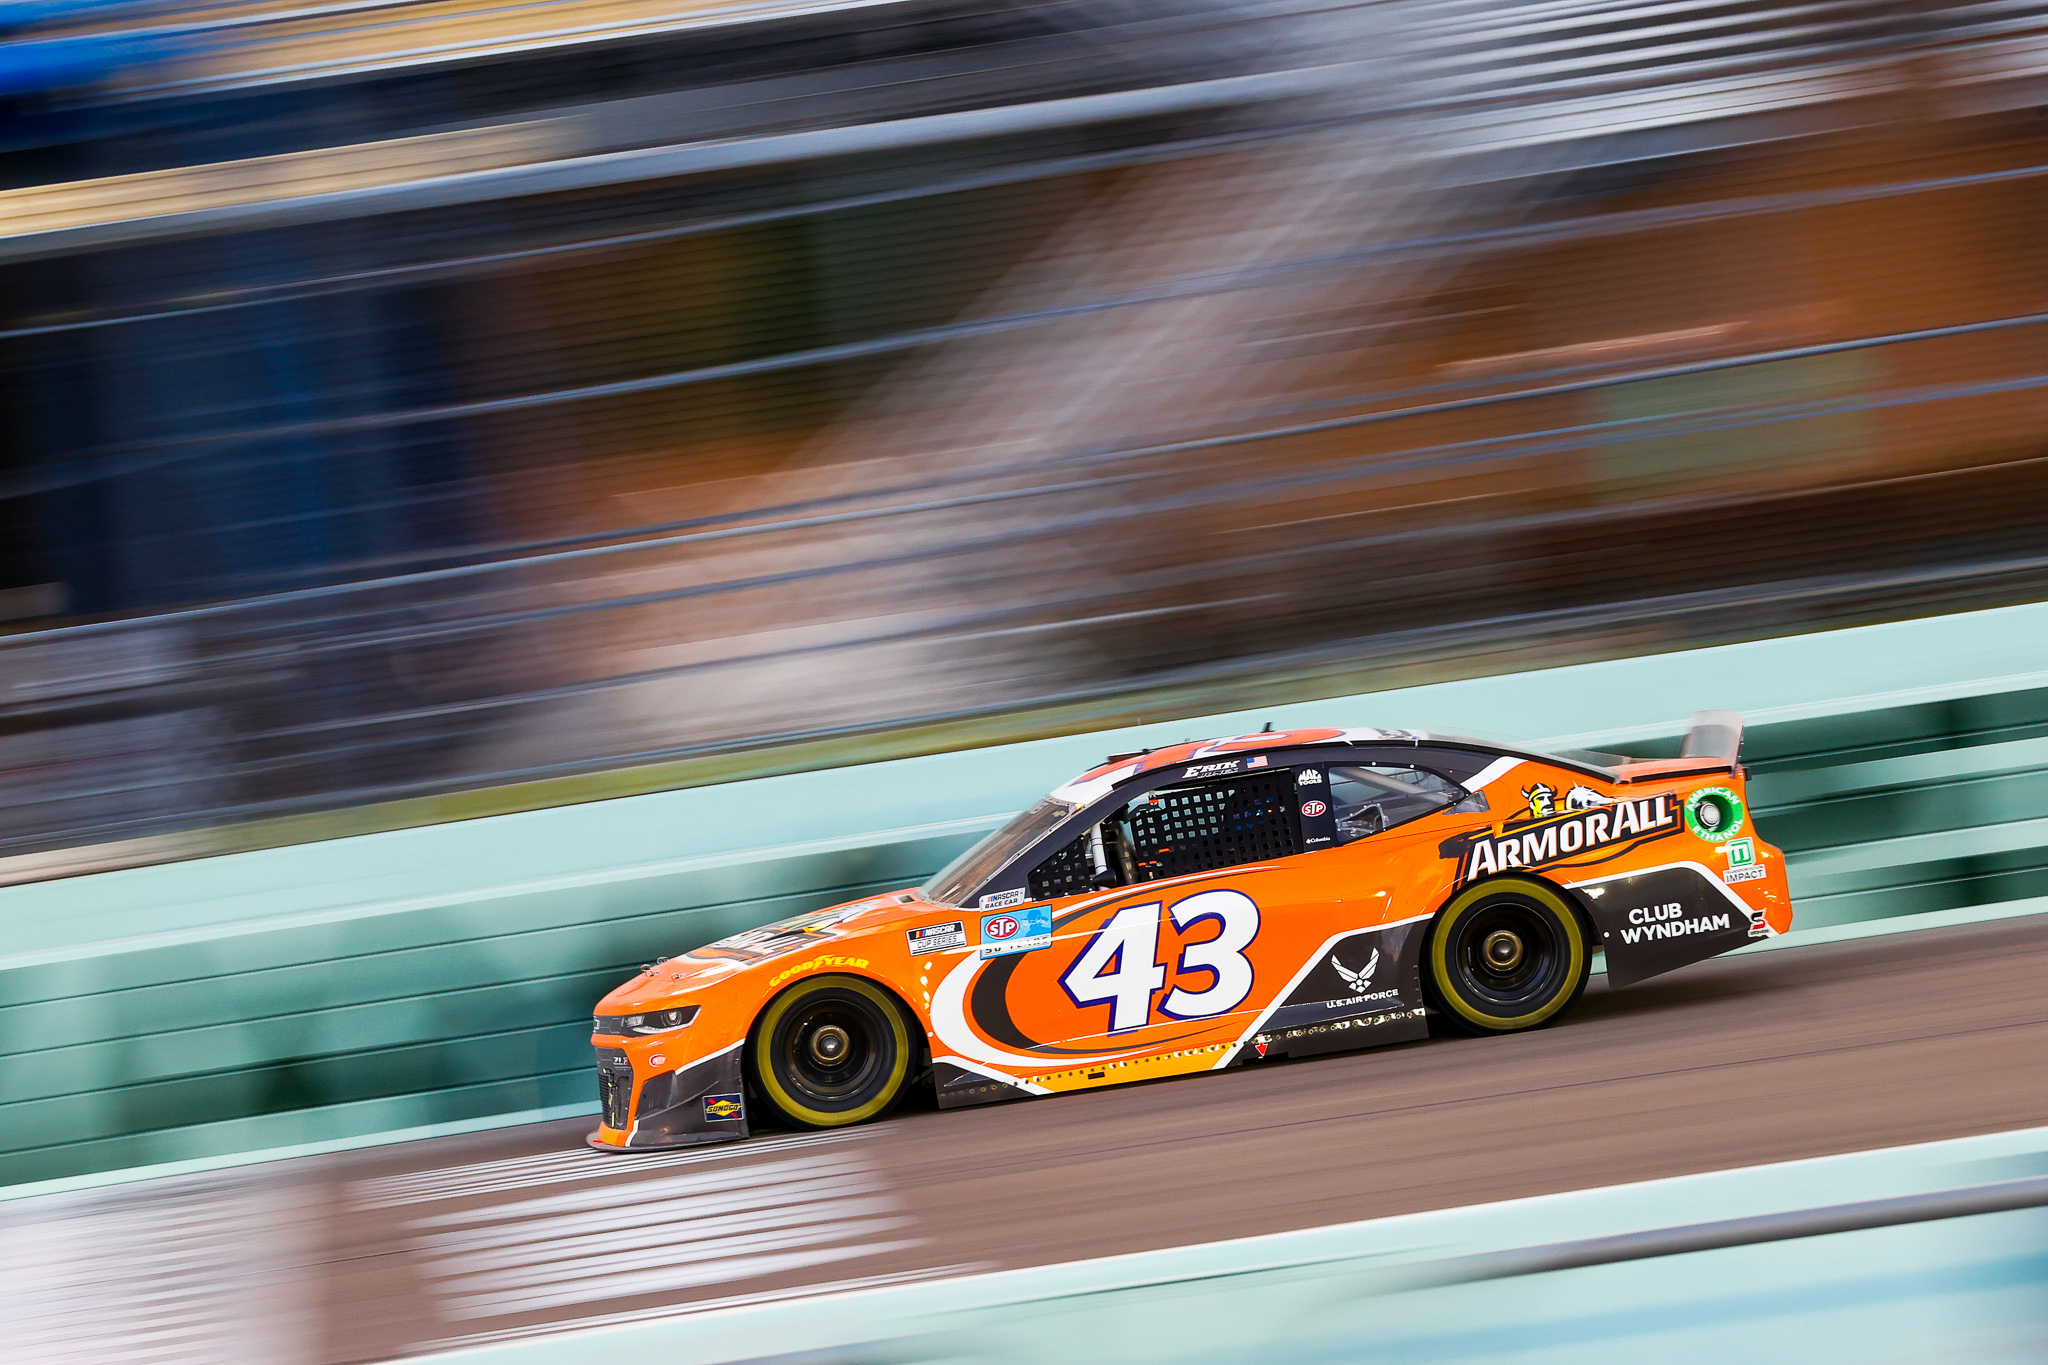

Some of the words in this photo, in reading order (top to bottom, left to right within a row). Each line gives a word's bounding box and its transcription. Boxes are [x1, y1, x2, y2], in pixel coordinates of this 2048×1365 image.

[1181, 760, 1240, 779] ERIK
[1299, 768, 1322, 780] MAC
[1298, 778, 1323, 786] TOOLS
[1686, 786, 1741, 812] AMERICAN
[1304, 802, 1323, 815] STP
[1692, 818, 1744, 842] ETHANOL
[1726, 869, 1764, 884] IMPACT
[993, 890, 1019, 901] NASCAR
[984, 900, 1002, 909] RACE
[1004, 898, 1018, 906] CAR
[1628, 902, 1683, 925] CLUB
[925, 924, 956, 937] NASCAR
[989, 918, 1016, 937] STP
[1619, 913, 1730, 945] WYNDHAM
[917, 938, 931, 949] CUP
[932, 935, 957, 947] SERIES
[768, 953, 870, 987] GOODYEAR
[1057, 888, 1261, 1037] 43
[707, 1103, 740, 1113] SUNOCO
